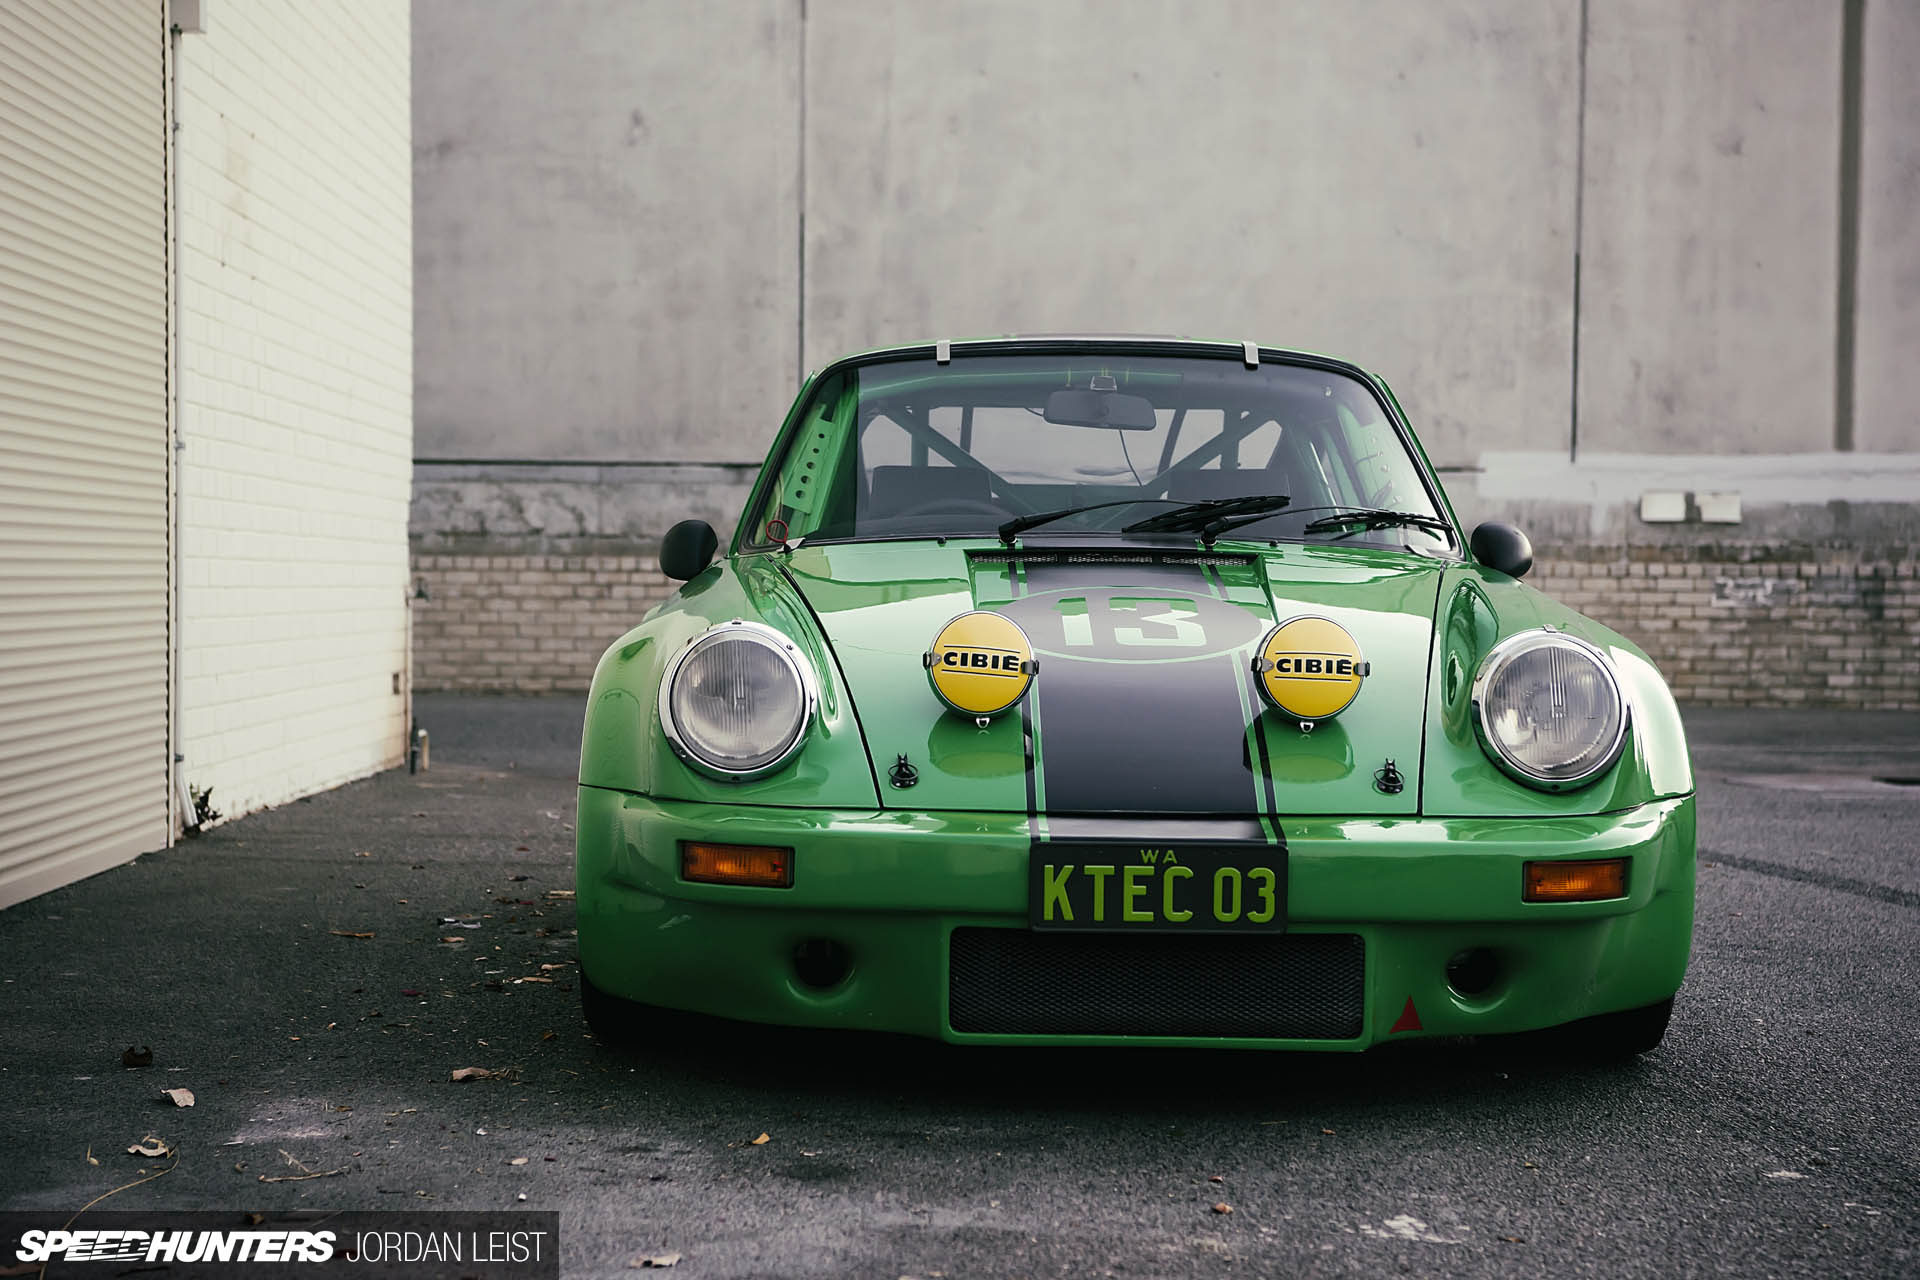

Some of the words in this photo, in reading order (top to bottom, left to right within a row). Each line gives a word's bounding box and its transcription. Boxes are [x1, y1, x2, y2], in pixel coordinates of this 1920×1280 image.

[1052, 596, 1207, 647] 13
[1140, 849, 1178, 865] WA
[1043, 864, 1194, 922] KTEC
[1213, 866, 1276, 923] 03
